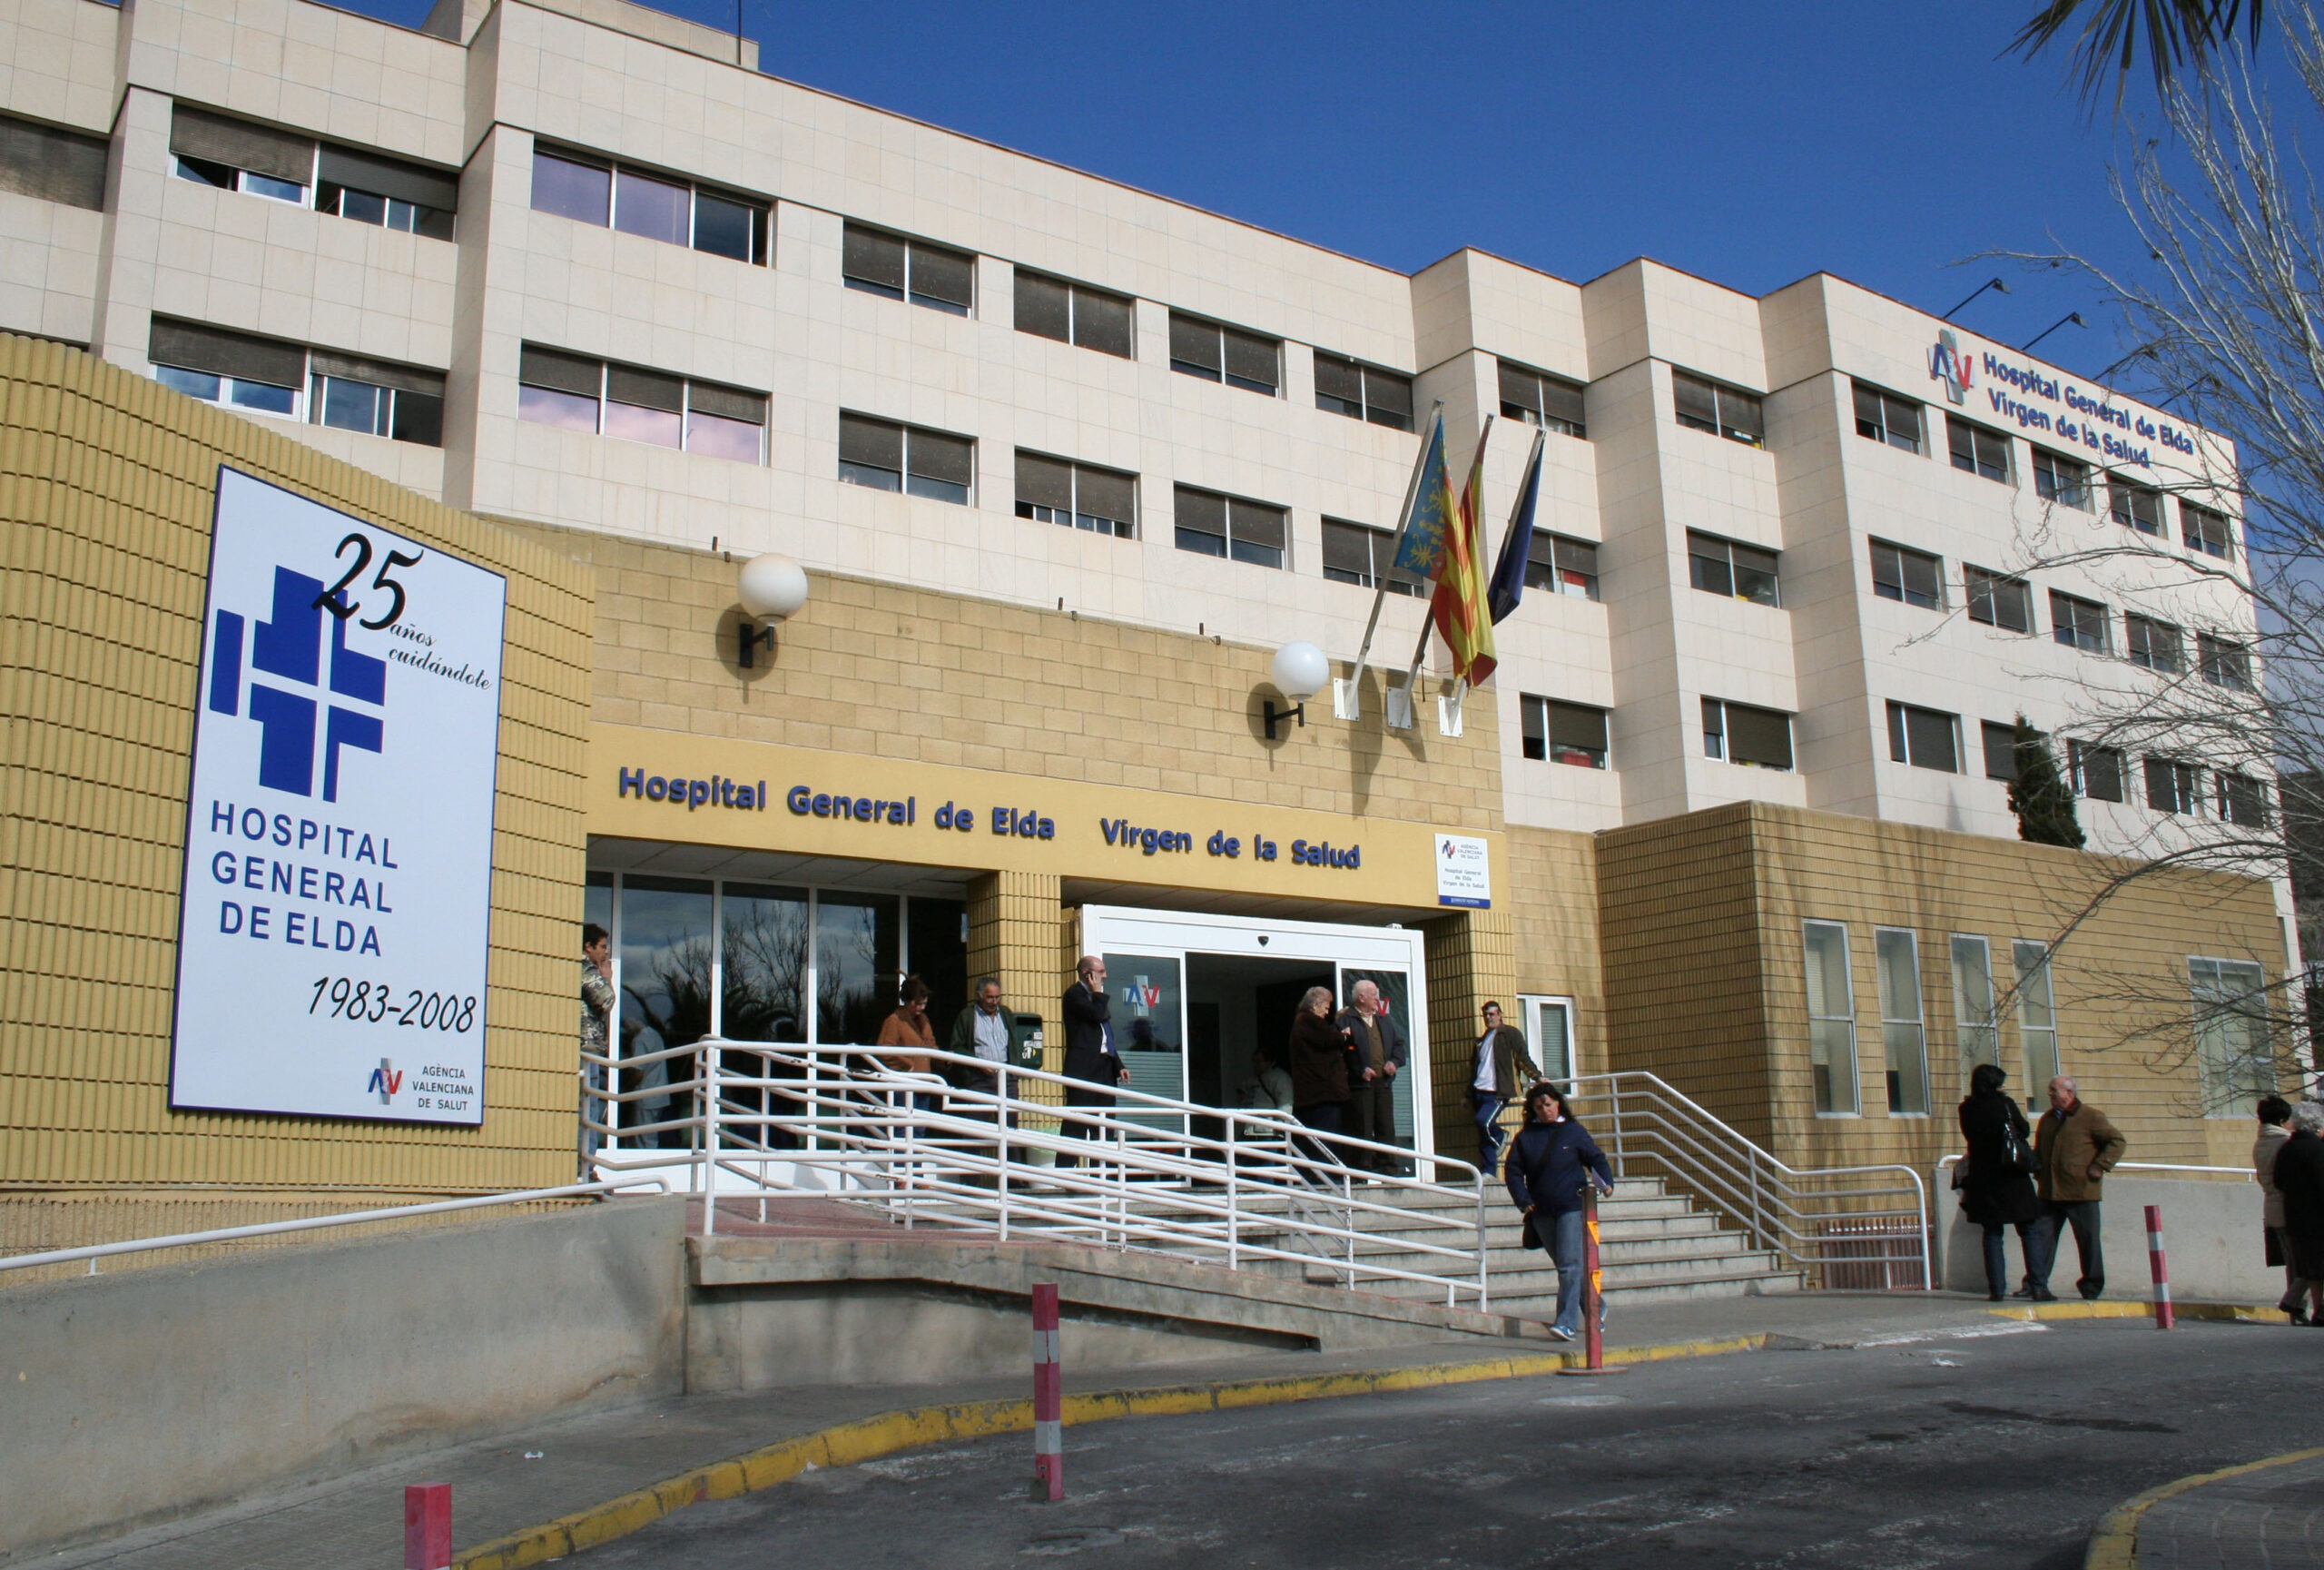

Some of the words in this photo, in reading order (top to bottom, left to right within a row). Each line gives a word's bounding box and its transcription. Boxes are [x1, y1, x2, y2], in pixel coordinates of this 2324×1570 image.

[1984, 351, 2060, 401] Hospital
[2064, 386, 2131, 430] General
[2135, 416, 2155, 440] de
[2160, 424, 2193, 455] Elda
[1988, 388, 2051, 430] Virgen
[2055, 415, 2079, 441] de
[2082, 423, 2099, 449] la
[2102, 433, 2150, 469] Salud
[311, 533, 424, 631] 25
[389, 622, 437, 647] años
[389, 648, 492, 691] cuidándote
[212, 800, 399, 869] HOSPITAL
[619, 765, 766, 811] Hospital
[787, 785, 916, 824] General
[935, 801, 974, 830] de
[992, 806, 1056, 839] Elda
[1100, 817, 1192, 854] Virgen
[1207, 829, 1240, 857] de
[1256, 834, 1278, 860] la
[1292, 839, 1361, 868] Salud
[212, 851, 392, 913] GENERAL
[221, 901, 271, 940] DE
[286, 912, 381, 957] ELDA
[309, 976, 477, 1033] 1983-2008
[412, 1081, 474, 1095] VALENCIANA
[422, 1063, 466, 1079] AGÈNCIA
[418, 1098, 431, 1109] DE
[438, 1099, 468, 1111] SALUT
